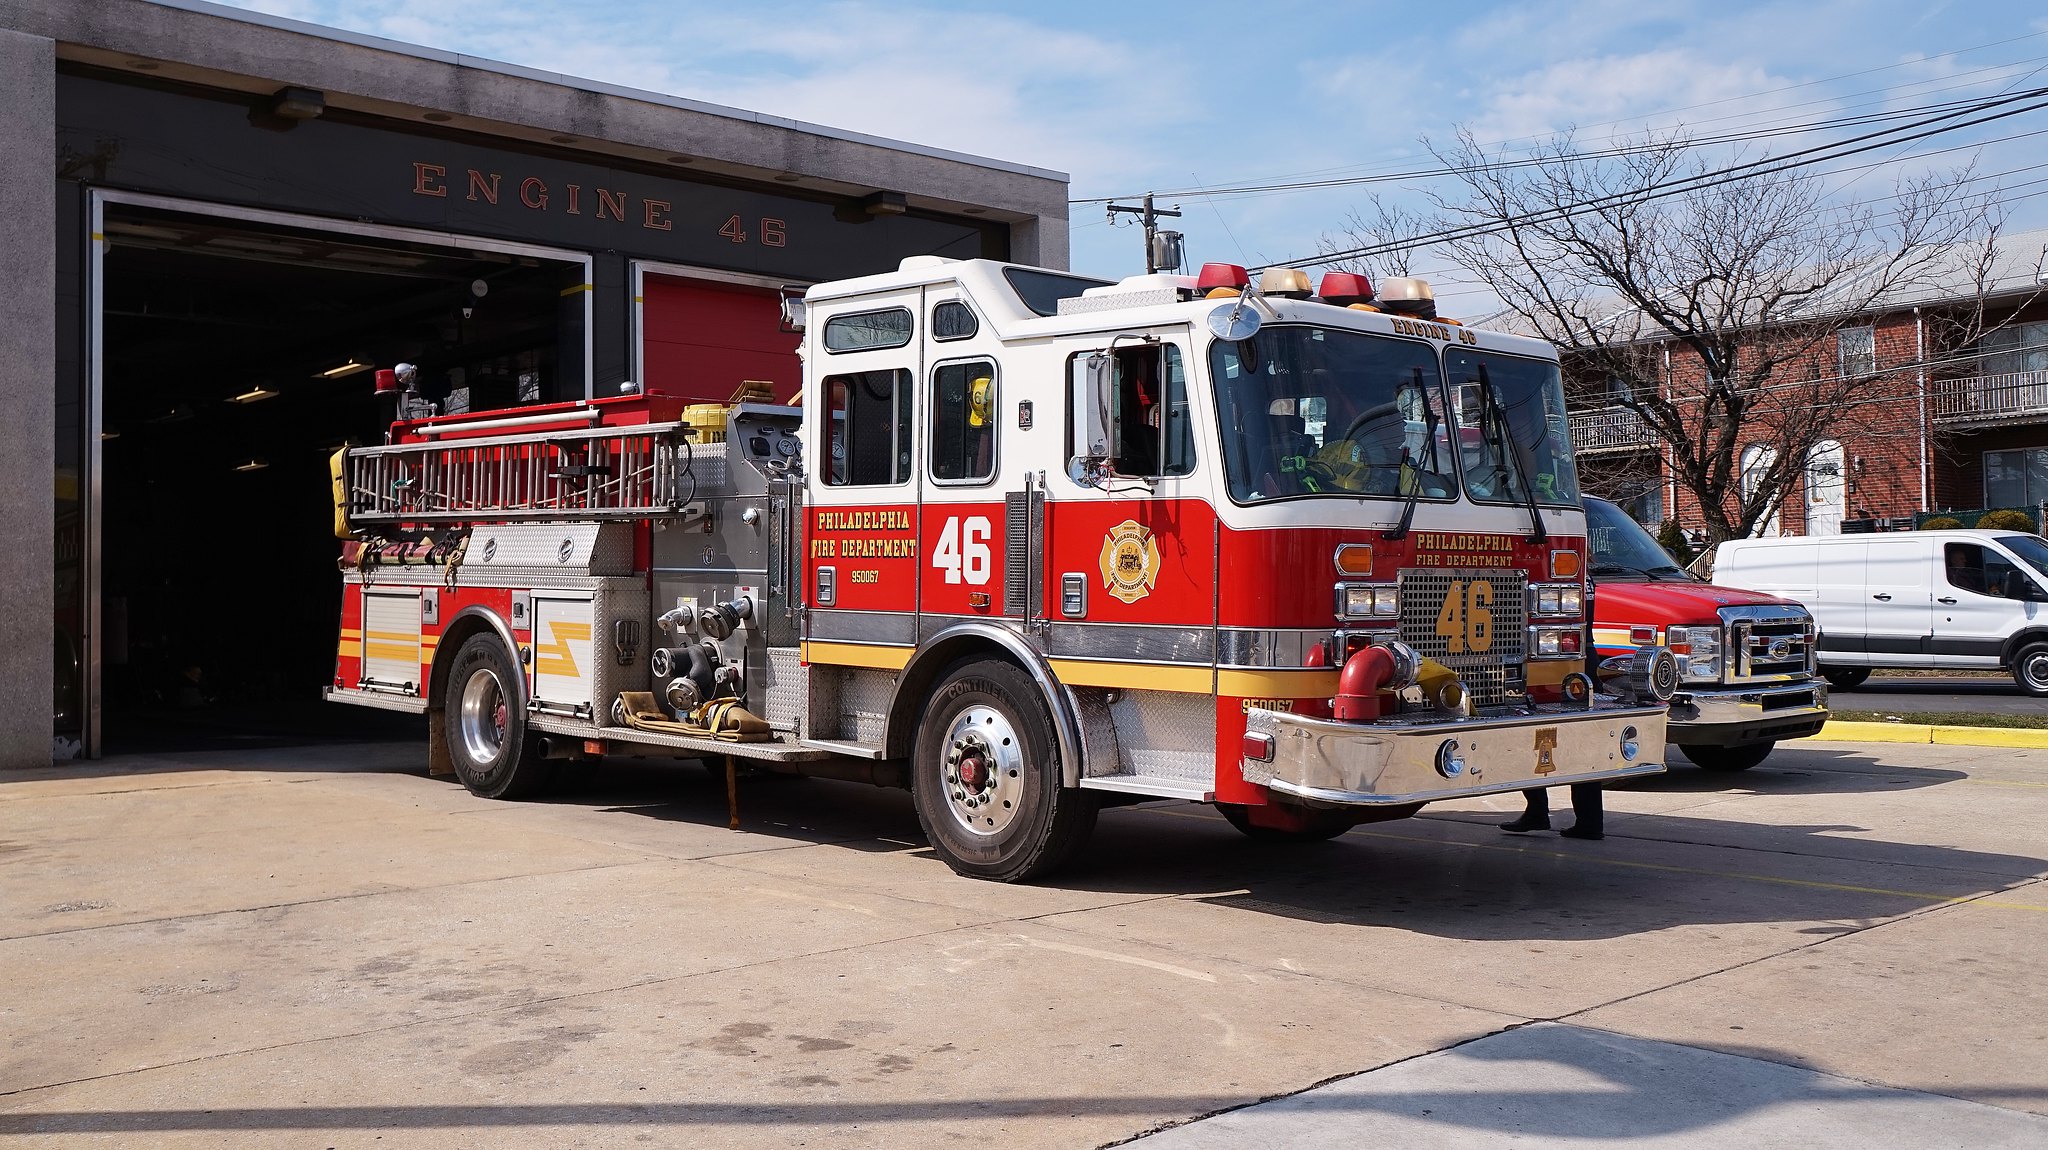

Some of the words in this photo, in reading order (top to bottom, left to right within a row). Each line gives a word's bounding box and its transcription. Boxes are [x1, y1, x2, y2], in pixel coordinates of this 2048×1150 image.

[413, 162, 672, 231] ENGINE
[718, 214, 786, 247] 46
[1391, 318, 1451, 341] ENGINE
[1459, 329, 1477, 345] 46
[818, 511, 909, 530] PHILADELPHIA
[811, 539, 836, 558] FIRE
[841, 539, 916, 558] DEPARTMENT
[1114, 533, 1146, 547] PHILADELPHIA
[1417, 534, 1513, 552] PHILADELPHIA
[932, 516, 992, 585] 46
[1416, 554, 1440, 566] FIRE
[1446, 555, 1513, 567] DEPARTMENT
[852, 570, 879, 583] 950067
[1120, 572, 1148, 590] DEPARTMENT
[1435, 580, 1493, 653] 46
